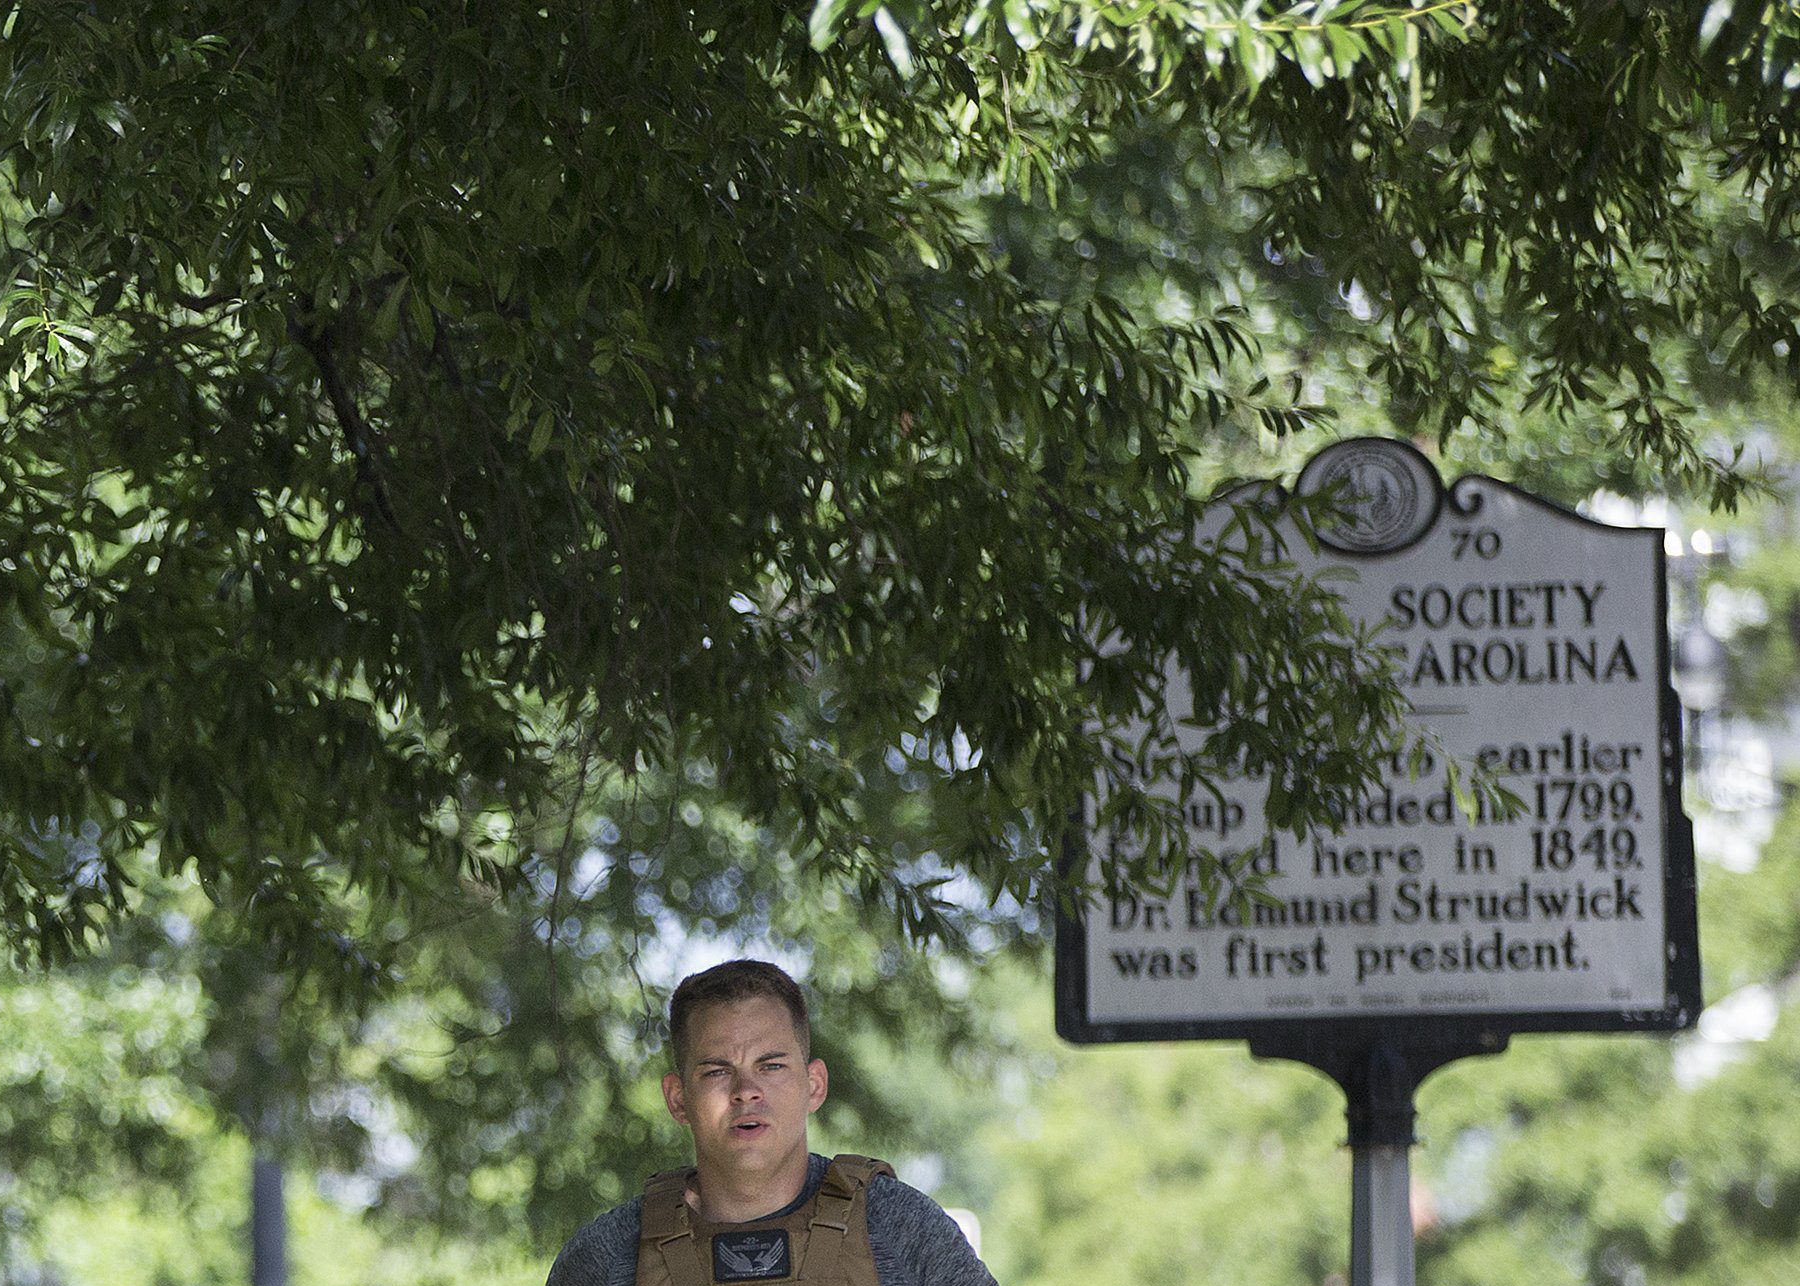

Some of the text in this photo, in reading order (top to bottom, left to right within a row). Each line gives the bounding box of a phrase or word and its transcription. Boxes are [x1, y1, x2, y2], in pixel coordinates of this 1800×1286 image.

[1452, 528, 1502, 560] 70
[1390, 580, 1606, 631] SOCIETY
[1475, 729, 1642, 776] earlier
[1533, 780, 1642, 824] 1799.
[1312, 829, 1424, 878] here
[1455, 832, 1498, 874] in
[1531, 828, 1644, 874] 1849.
[1392, 874, 1646, 925] Strudwick
[1109, 926, 1591, 986] was first president.
